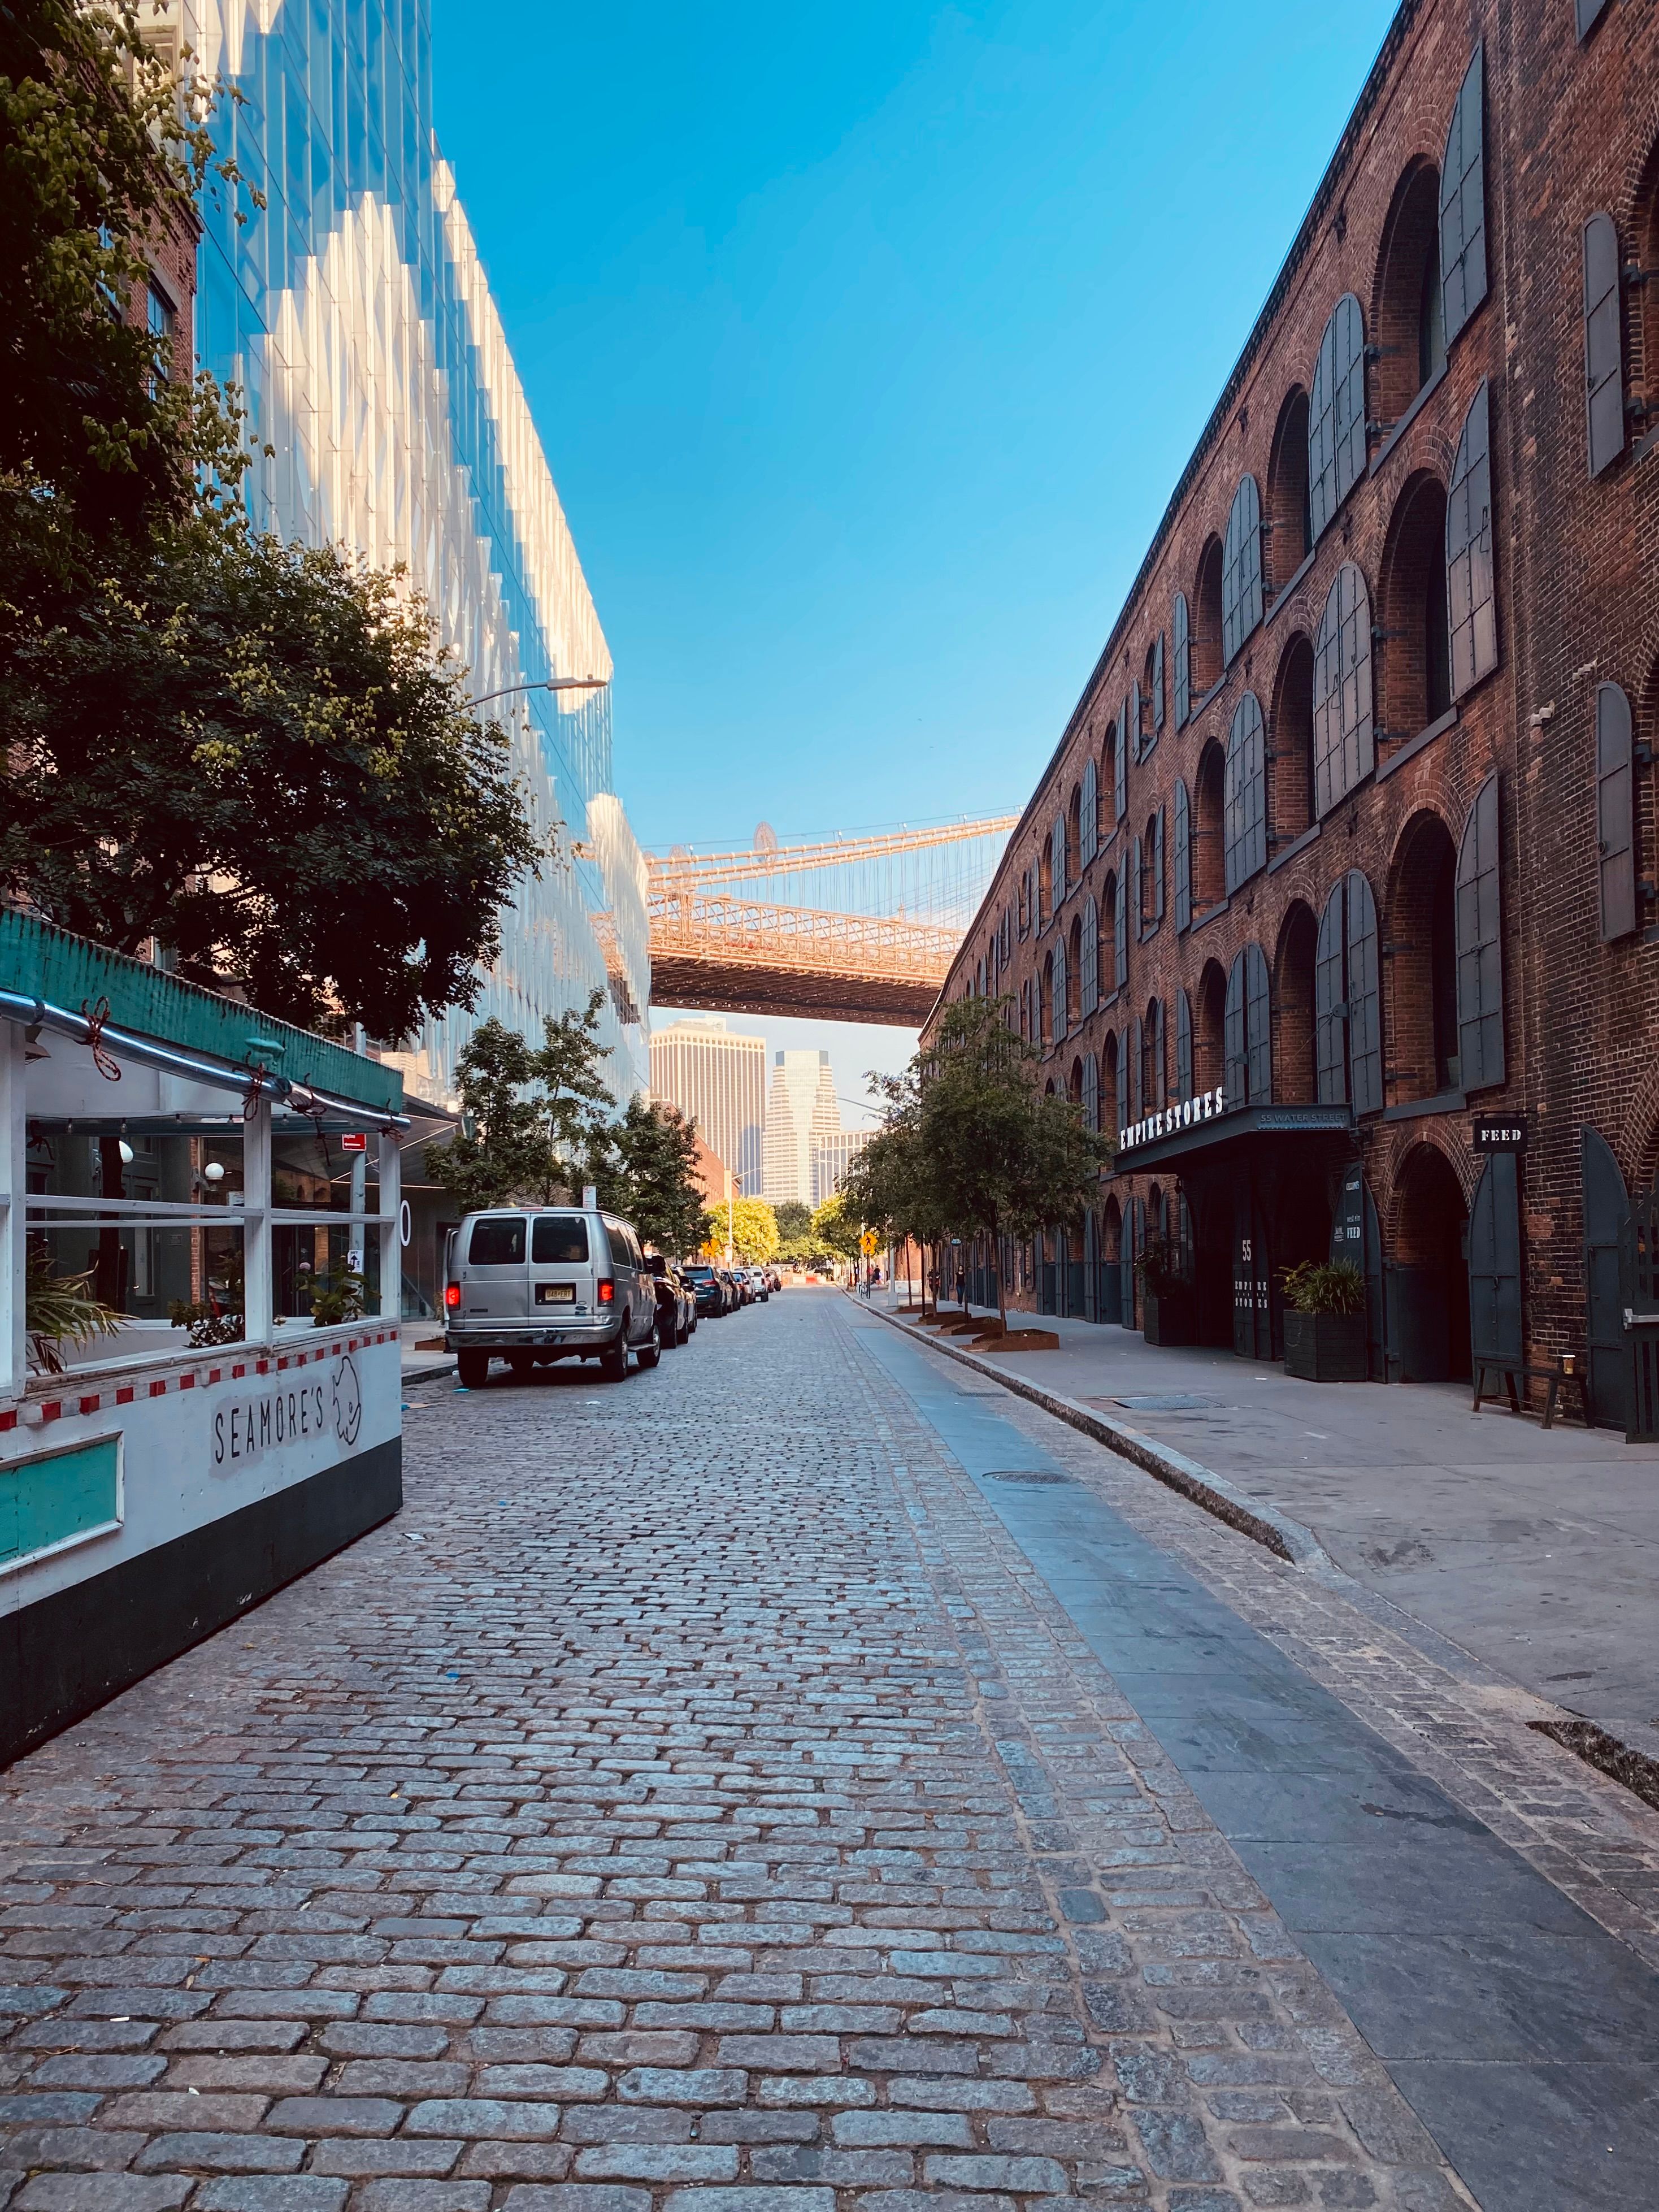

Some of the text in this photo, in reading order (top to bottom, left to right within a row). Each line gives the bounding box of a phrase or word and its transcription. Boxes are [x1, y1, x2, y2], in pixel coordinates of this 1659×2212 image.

[1121, 1086, 1223, 1151] EMPIRE STORES
[1311, 1113, 1346, 1122] STREET
[1481, 1130, 1521, 1140] FEED
[1243, 1239, 1252, 1261] 55
[215, 1386, 323, 1464] SEAMORE'S
